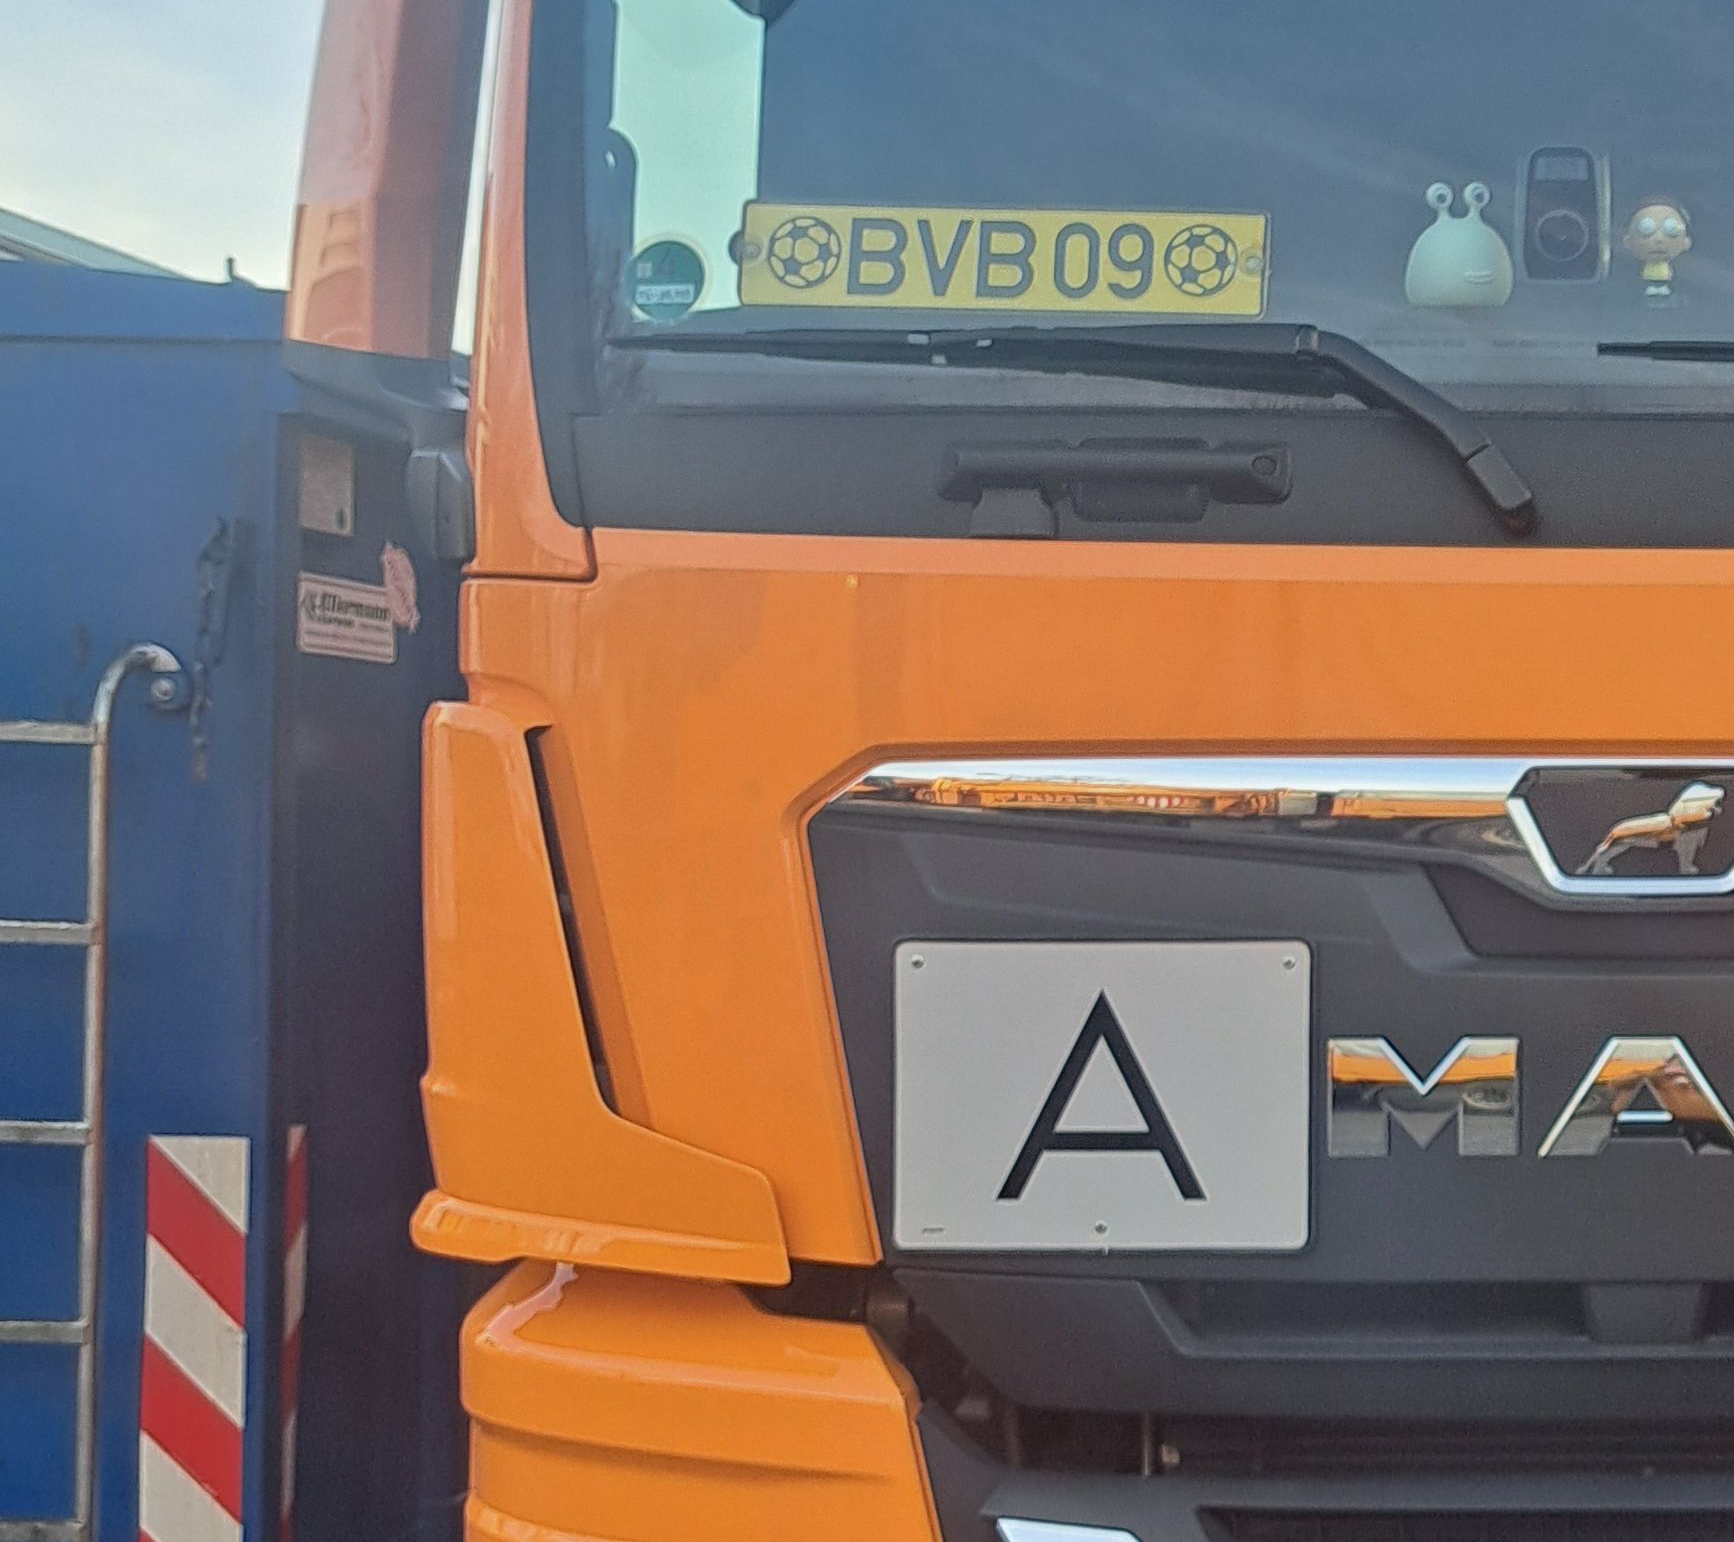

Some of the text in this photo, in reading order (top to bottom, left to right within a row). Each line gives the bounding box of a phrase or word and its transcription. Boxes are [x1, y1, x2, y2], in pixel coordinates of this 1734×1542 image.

[845, 216, 1154, 300] BVB 09
[995, 990, 1207, 1201] A
